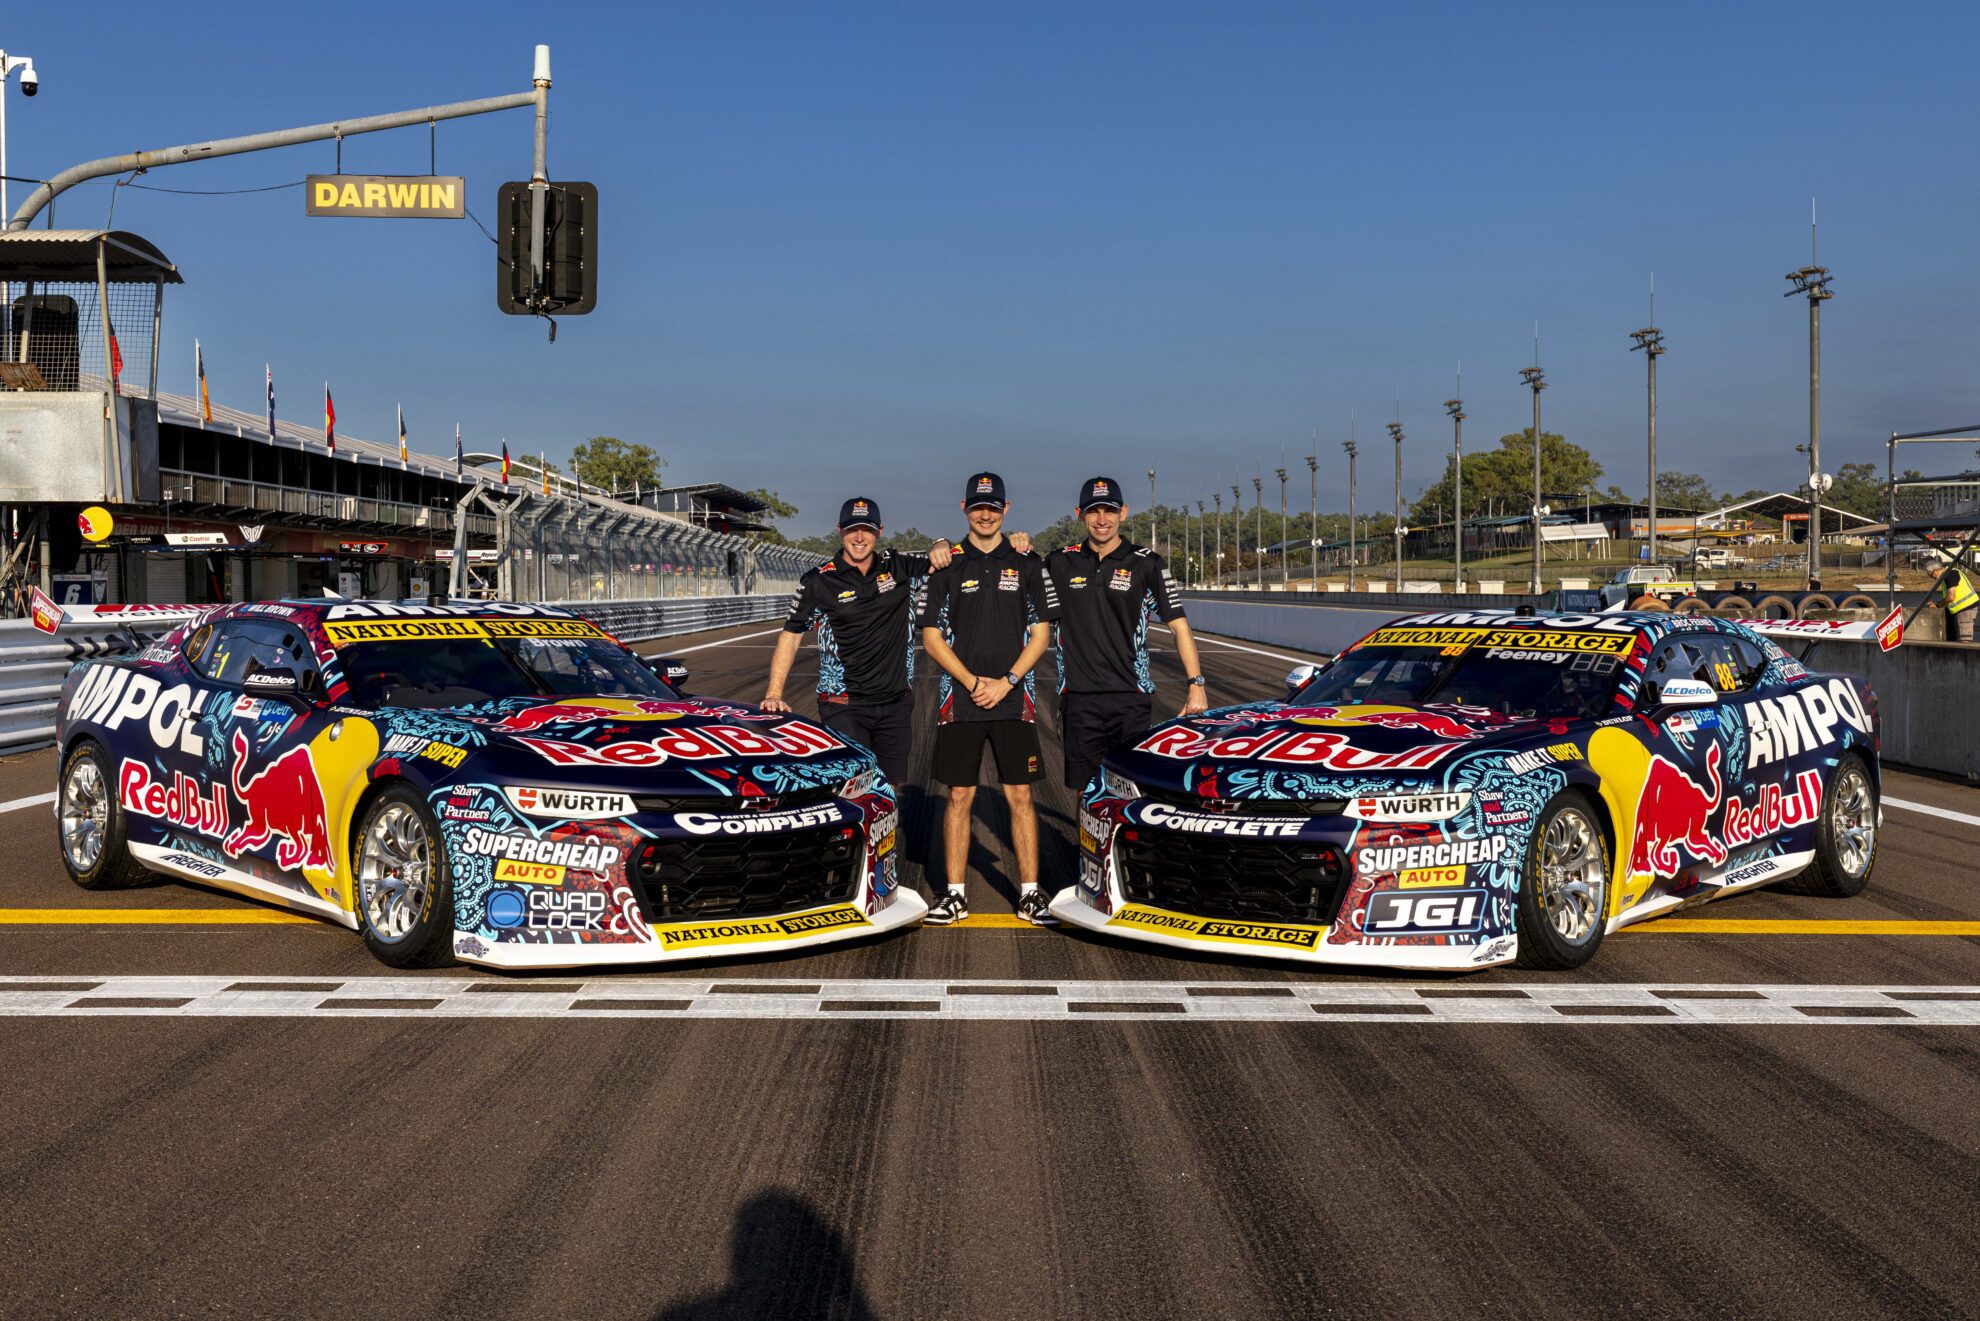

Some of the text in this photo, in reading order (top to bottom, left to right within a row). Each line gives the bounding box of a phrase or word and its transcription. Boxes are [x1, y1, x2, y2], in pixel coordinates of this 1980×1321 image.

[315, 183, 455, 209] DARWIN
[64, 584, 82, 605] 6
[247, 604, 297, 618] WILL BROWN
[329, 620, 600, 641] NATIONAL STORAGE
[1393, 612, 1638, 631] AMPOL
[1730, 619, 1854, 629] PLIFY
[1766, 625, 1843, 635] Fuels
[530, 637, 588, 648] Brown
[1366, 629, 1626, 652] NATIONAL STORAGE
[1440, 646, 1465, 657] 88
[1485, 648, 1573, 664] Feeney
[247, 674, 296, 685] ACDelco
[1714, 663, 1737, 692] 88
[1664, 687, 1712, 695] ACDelco
[66, 664, 209, 757] AMPOL
[1600, 715, 1633, 726] DUNLOP
[1743, 677, 1874, 770] AMPOL
[382, 733, 468, 769] MAKE IT SUPER
[1504, 742, 1585, 776] MAKE IT SUPER
[452, 785, 482, 796] Shaw
[1478, 790, 1504, 802] Shaw
[447, 797, 471, 807] and
[1482, 801, 1501, 812] and
[445, 805, 490, 820] Partners
[673, 807, 843, 835] COMPLETE
[1139, 802, 1306, 837] COMPLETE
[1173, 809, 1199, 818] PARTS
[1485, 810, 1529, 824] Partners
[463, 828, 619, 872] SUPERCHEAP
[1357, 835, 1506, 874] SUPERCHEAP
[502, 864, 558, 880] AUTO
[1405, 869, 1458, 883] AUTO
[529, 891, 606, 911] QUAD
[528, 912, 605, 930] LOCK
[1375, 896, 1477, 929] JGI
[662, 909, 862, 945] NATIONAL STORAGE
[1114, 909, 1318, 945] NATIONAL STORAGE
